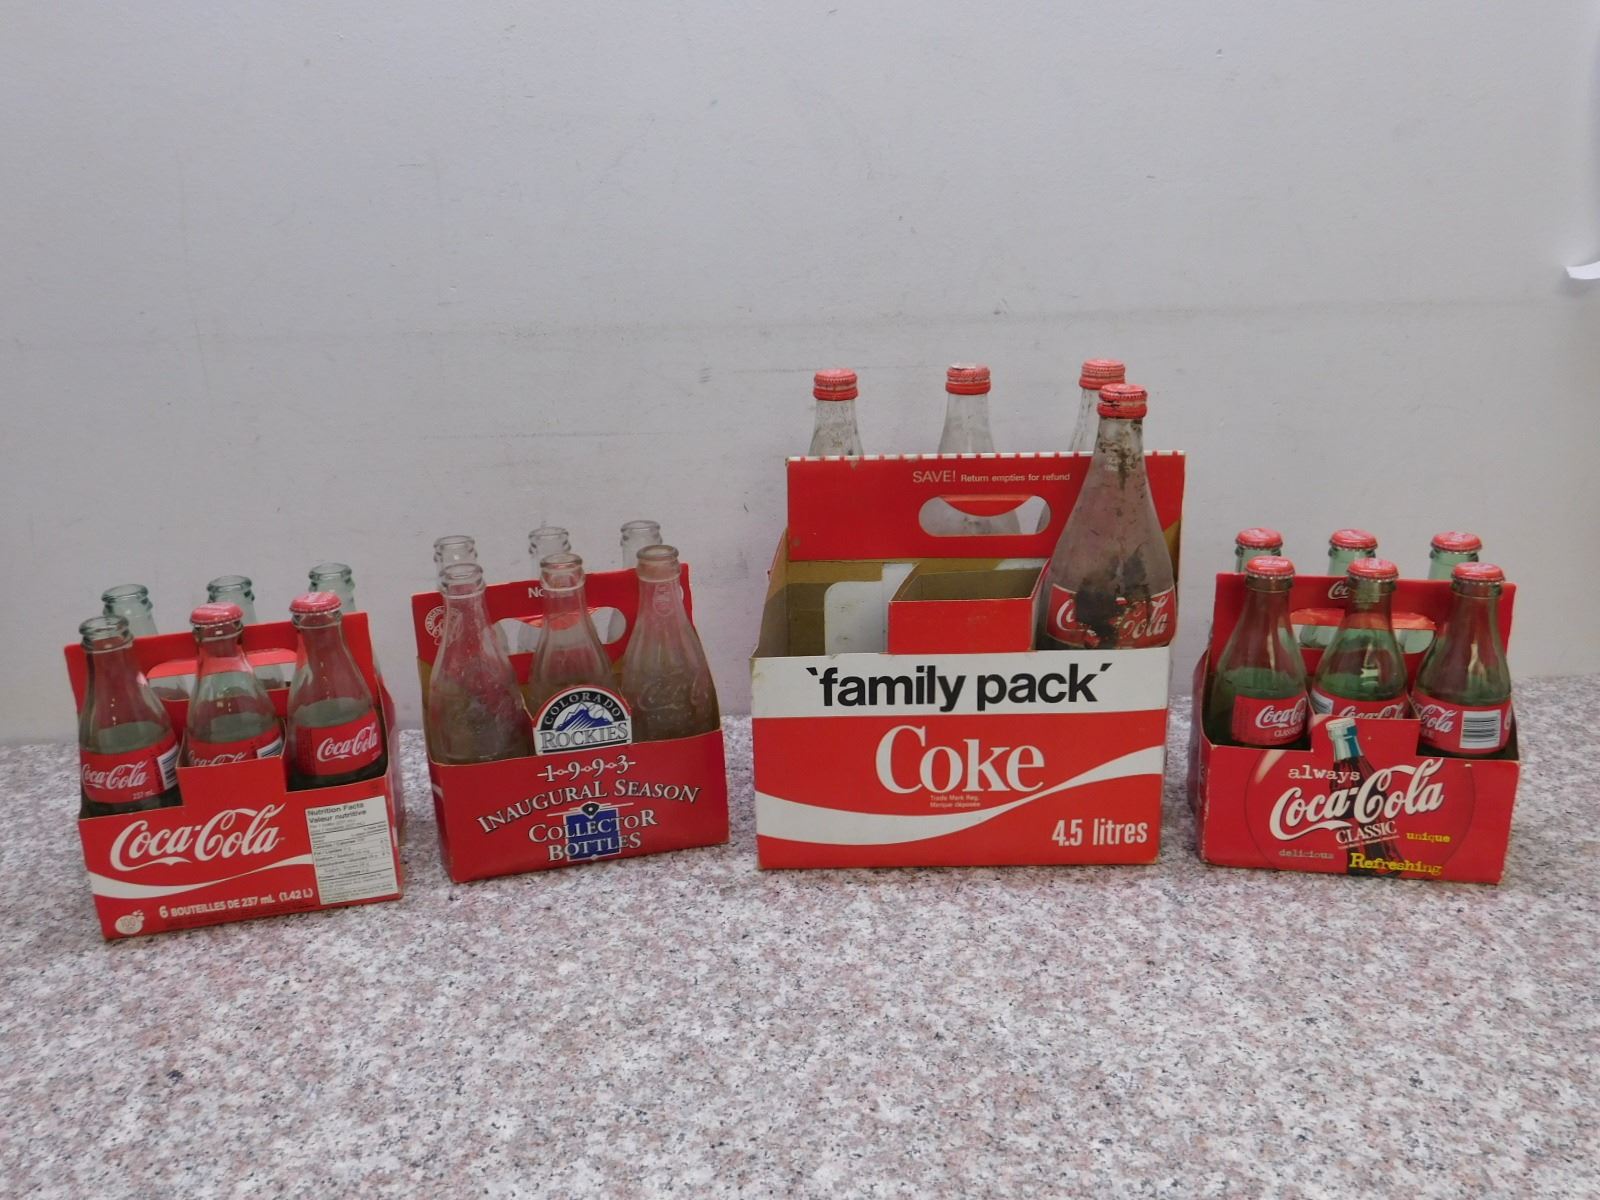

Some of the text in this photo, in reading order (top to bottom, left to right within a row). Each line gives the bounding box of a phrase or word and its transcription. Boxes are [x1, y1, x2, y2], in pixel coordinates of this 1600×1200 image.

[912, 470, 1071, 484] SAVE! Return empties for refund
[543, 692, 621, 725] COLORADO
[540, 722, 629, 749] ROCKIES
[874, 724, 1046, 794] Coke
[1288, 764, 1361, 784] always
[308, 802, 364, 817] Nutrition Facts
[476, 778, 702, 834] INAUGURAL SEASON
[1269, 758, 1445, 841] Coca-Cola
[110, 802, 287, 872] Coca-Cola
[527, 808, 658, 844] COLLECTOR
[1051, 817, 1148, 847] 4.5 litres
[1335, 820, 1398, 845] CLASSIC
[1406, 832, 1451, 844] unique
[548, 831, 642, 863] BOTTLES
[1279, 849, 1334, 860] delicious
[1349, 851, 1443, 876] Refreshing
[159, 905, 169, 918] 6
[170, 901, 226, 917] BOUTEILLES
[227, 899, 240, 910] DE
[241, 896, 258, 908] 237
